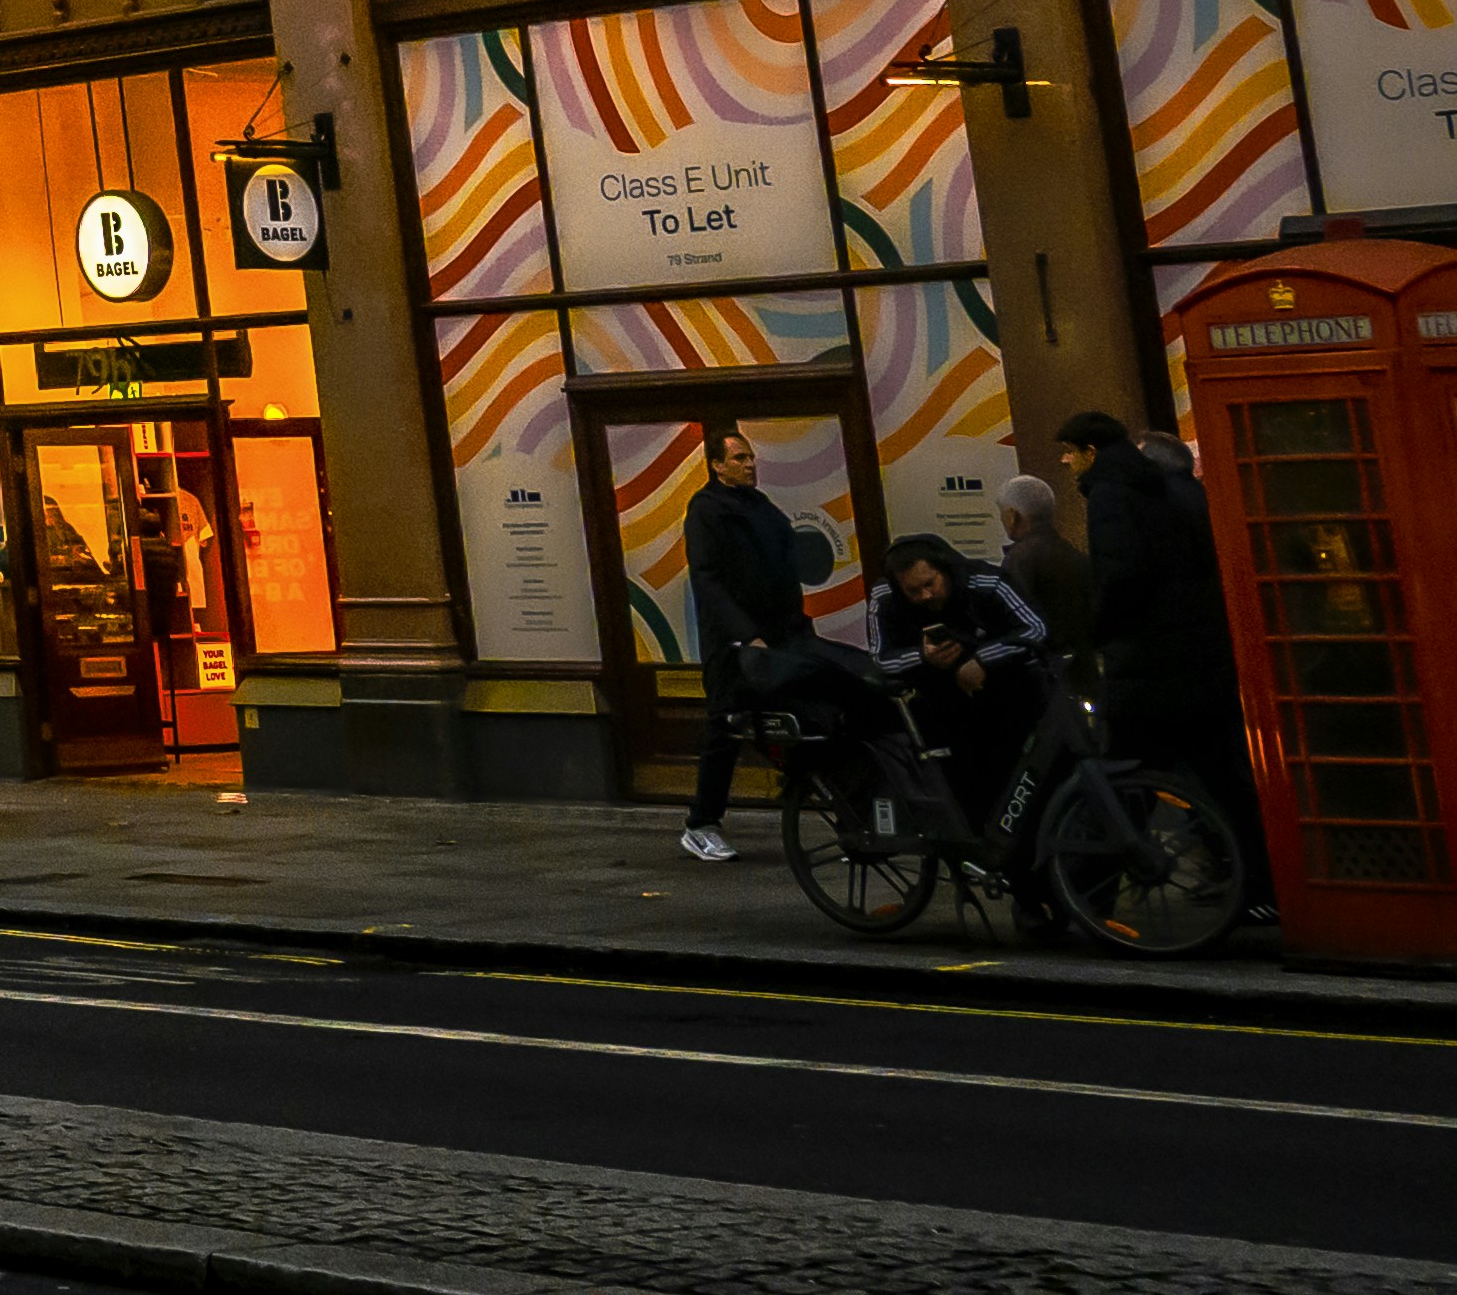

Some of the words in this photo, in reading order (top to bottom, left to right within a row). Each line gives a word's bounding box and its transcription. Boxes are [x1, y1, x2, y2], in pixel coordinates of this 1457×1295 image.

[600, 173, 678, 202] Class
[684, 165, 706, 194] E
[711, 160, 773, 191] Unit
[266, 178, 293, 223] B
[641, 209, 680, 237] To
[686, 203, 738, 233] Let
[100, 211, 125, 257] B
[260, 226, 308, 242] BAGEL
[666, 254, 682, 266] 79
[683, 251, 723, 265] Strand
[96, 260, 139, 278] BAGEL
[1219, 316, 1367, 347] TELEPHONE
[793, 511, 820, 522] Look
[203, 649, 225, 659] YOUR
[202, 661, 228, 671] BAGEL
[205, 671, 226, 681] LOVE
[1000, 771, 1036, 833] PORT
